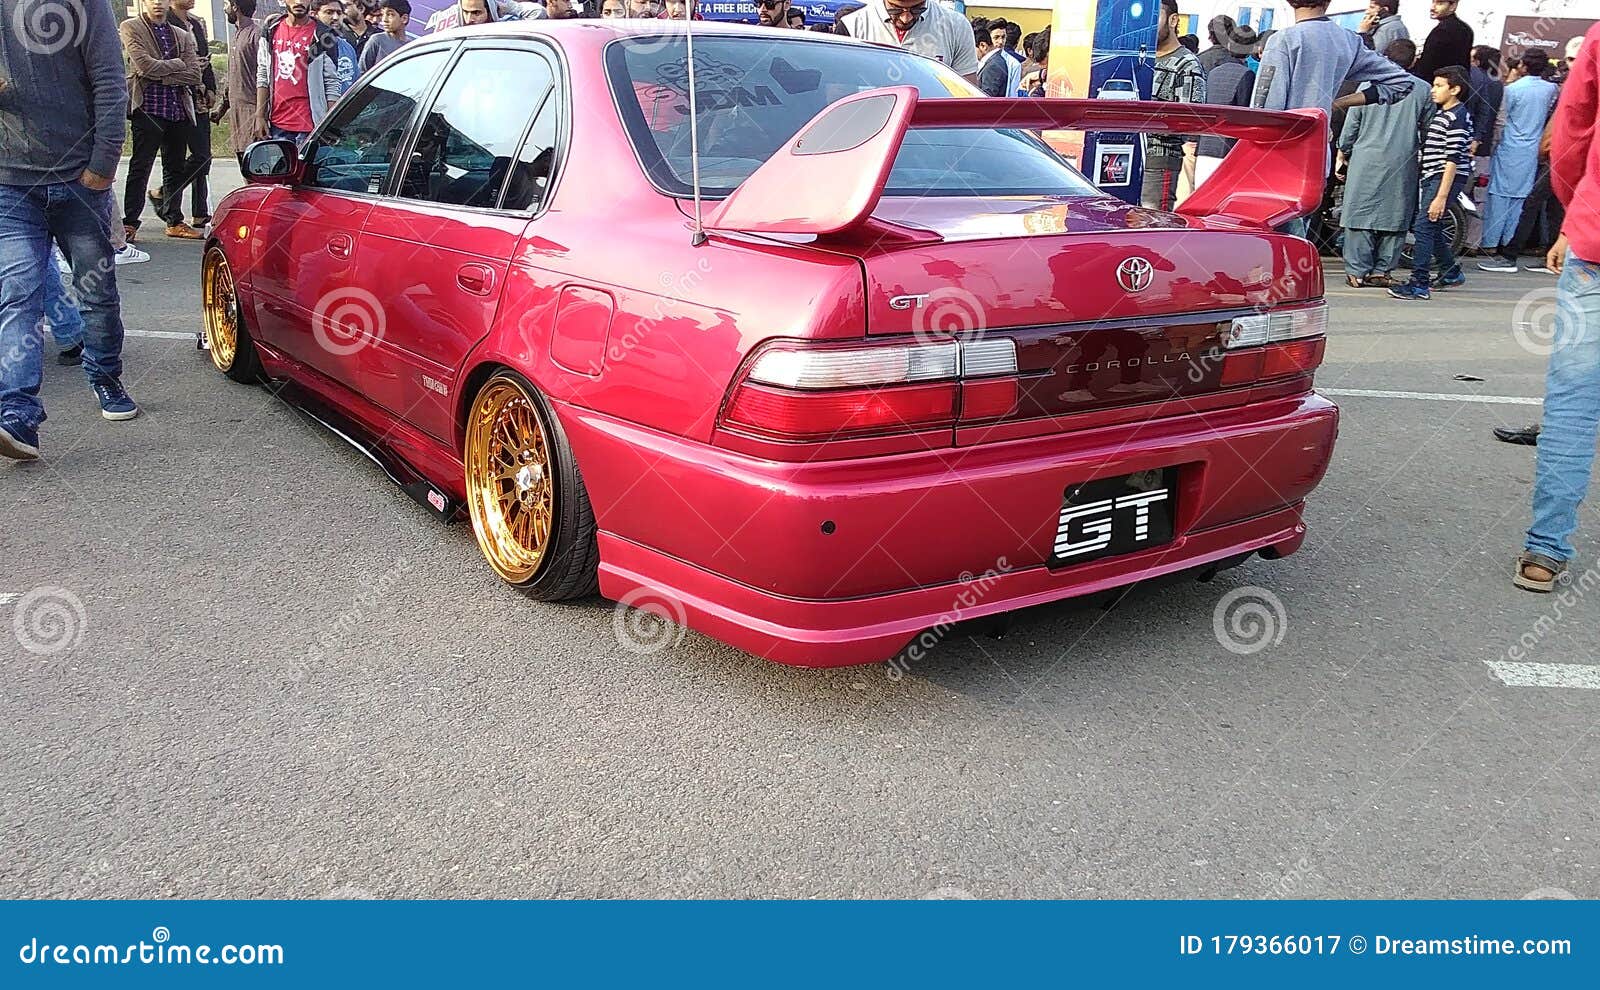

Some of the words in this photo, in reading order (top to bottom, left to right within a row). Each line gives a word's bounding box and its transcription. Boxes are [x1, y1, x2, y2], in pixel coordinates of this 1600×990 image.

[704, 3, 711, 13] A
[714, 3, 738, 13] FREE
[890, 293, 929, 310] GT
[1066, 352, 1191, 374] COROLLA
[1054, 488, 1169, 559] GT
